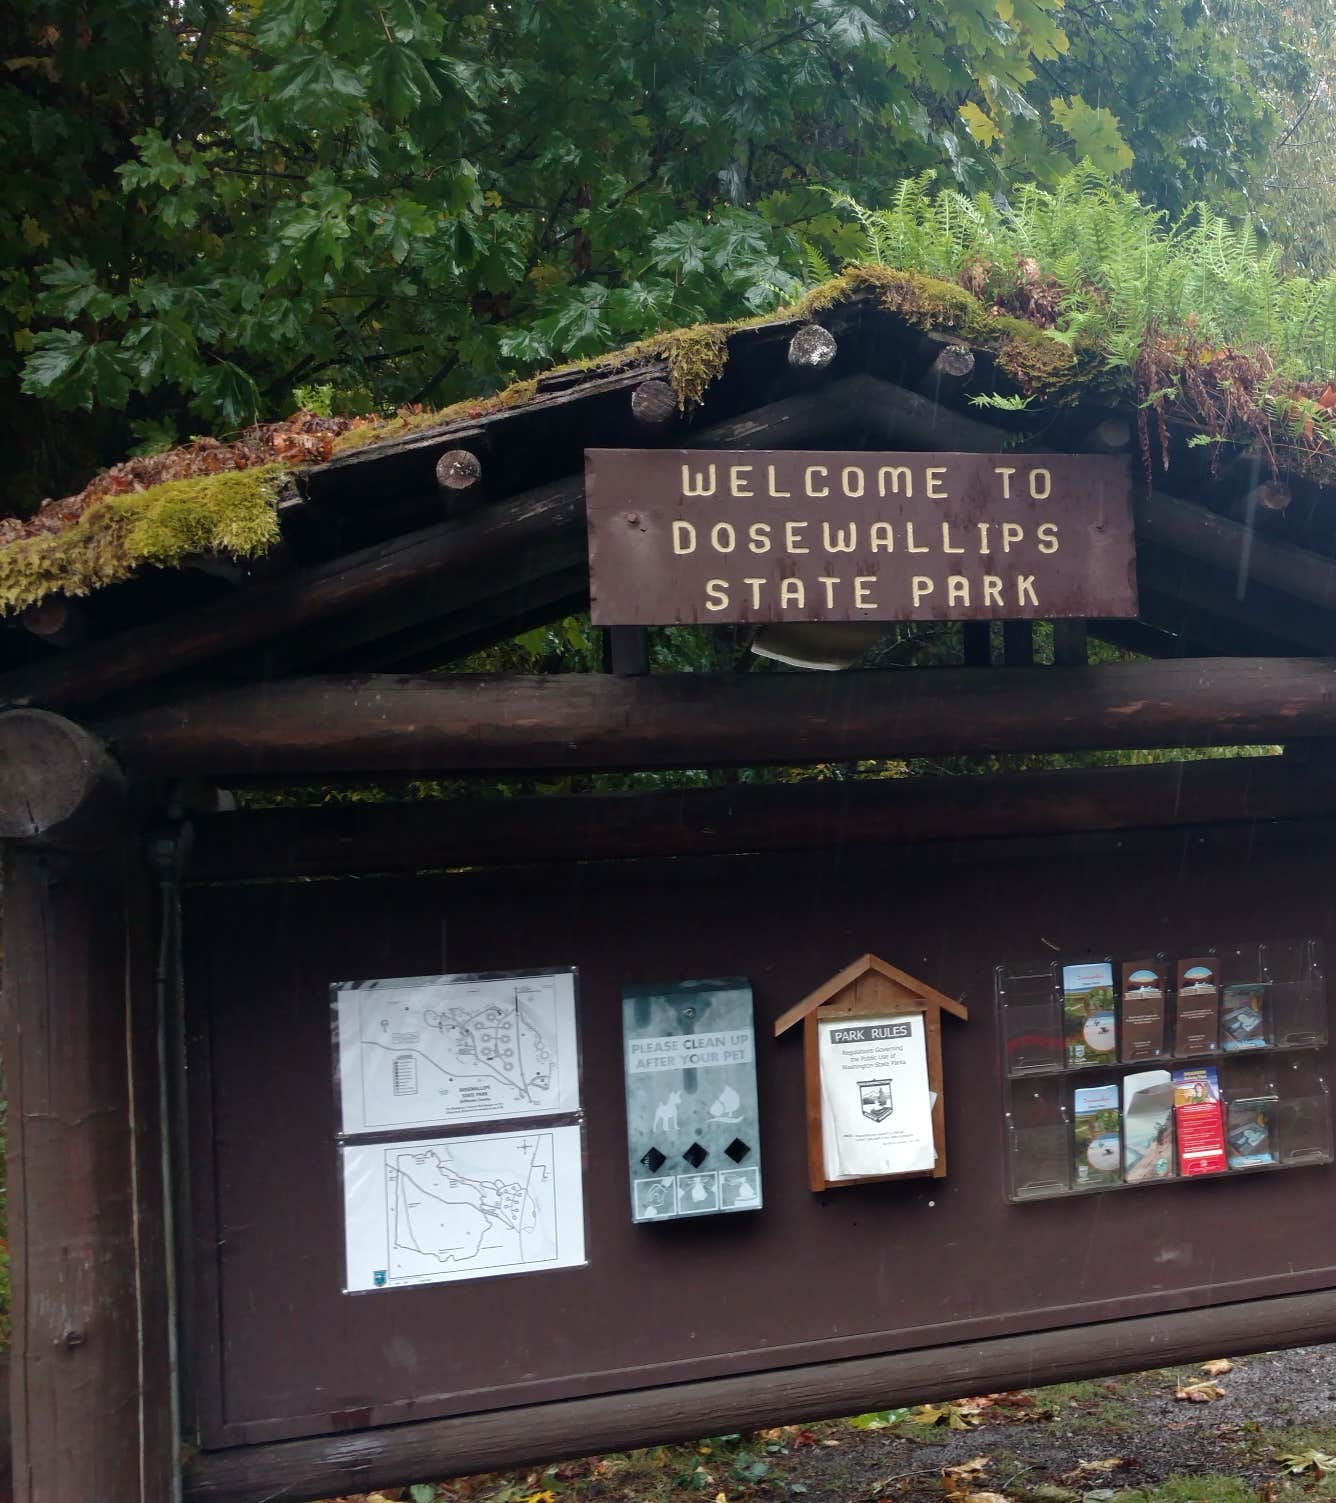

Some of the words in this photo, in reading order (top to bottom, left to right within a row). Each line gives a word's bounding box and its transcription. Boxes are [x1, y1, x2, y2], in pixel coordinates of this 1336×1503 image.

[681, 463, 948, 498] WELCOME
[993, 466, 1053, 500] TO
[672, 520, 1060, 555] DOSEWALLIPS
[705, 575, 878, 611] STATE
[911, 574, 1040, 608] PARK
[631, 1040, 680, 1055] PLEASE
[683, 1036, 726, 1050] CLEAN
[731, 1034, 749, 1046] UP
[834, 1030, 865, 1042] PARK
[871, 1025, 908, 1039] RULES
[635, 1056, 675, 1069] AFTER
[680, 1052, 720, 1066] YOUR
[723, 1049, 745, 1062] PET
